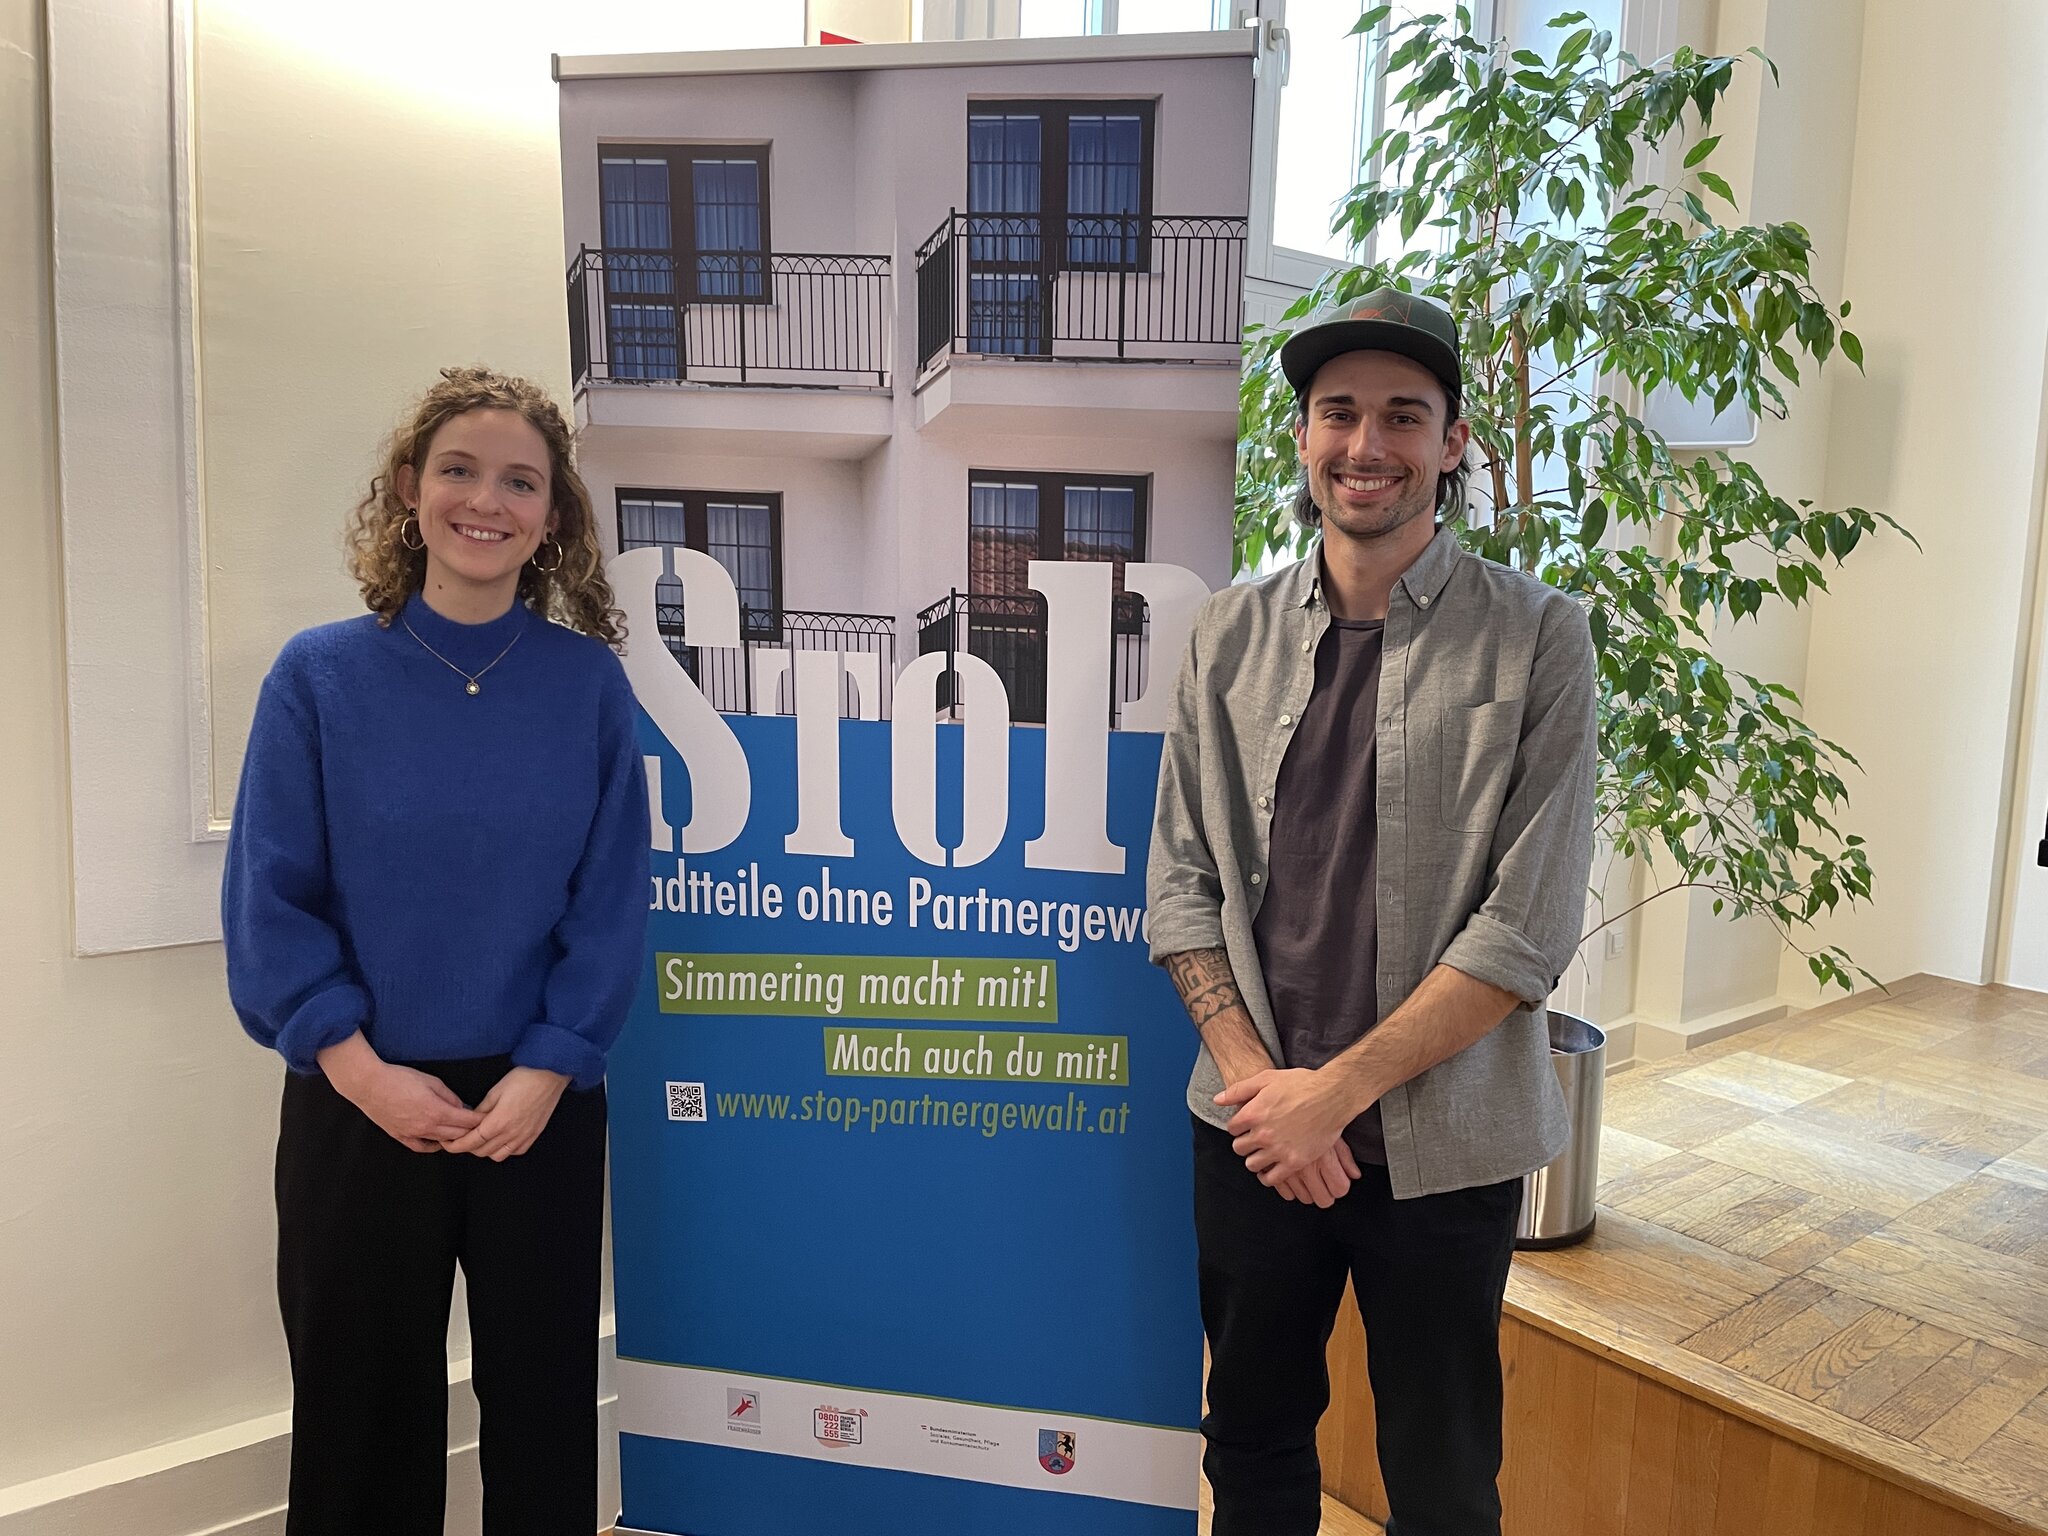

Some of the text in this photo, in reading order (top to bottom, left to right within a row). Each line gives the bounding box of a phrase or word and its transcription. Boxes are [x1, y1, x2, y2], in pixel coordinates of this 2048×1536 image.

[650, 857, 784, 919] adtteile
[797, 866, 894, 927] ohne
[665, 958, 1048, 1015] Simmering macht mit!
[832, 1033, 1119, 1080] Mach auch du mit!
[716, 1090, 1131, 1138] www.stop-partnergewalt.at
[818, 1412, 839, 1422] 0800
[823, 1421, 839, 1431] 222
[823, 1429, 839, 1438] 555
